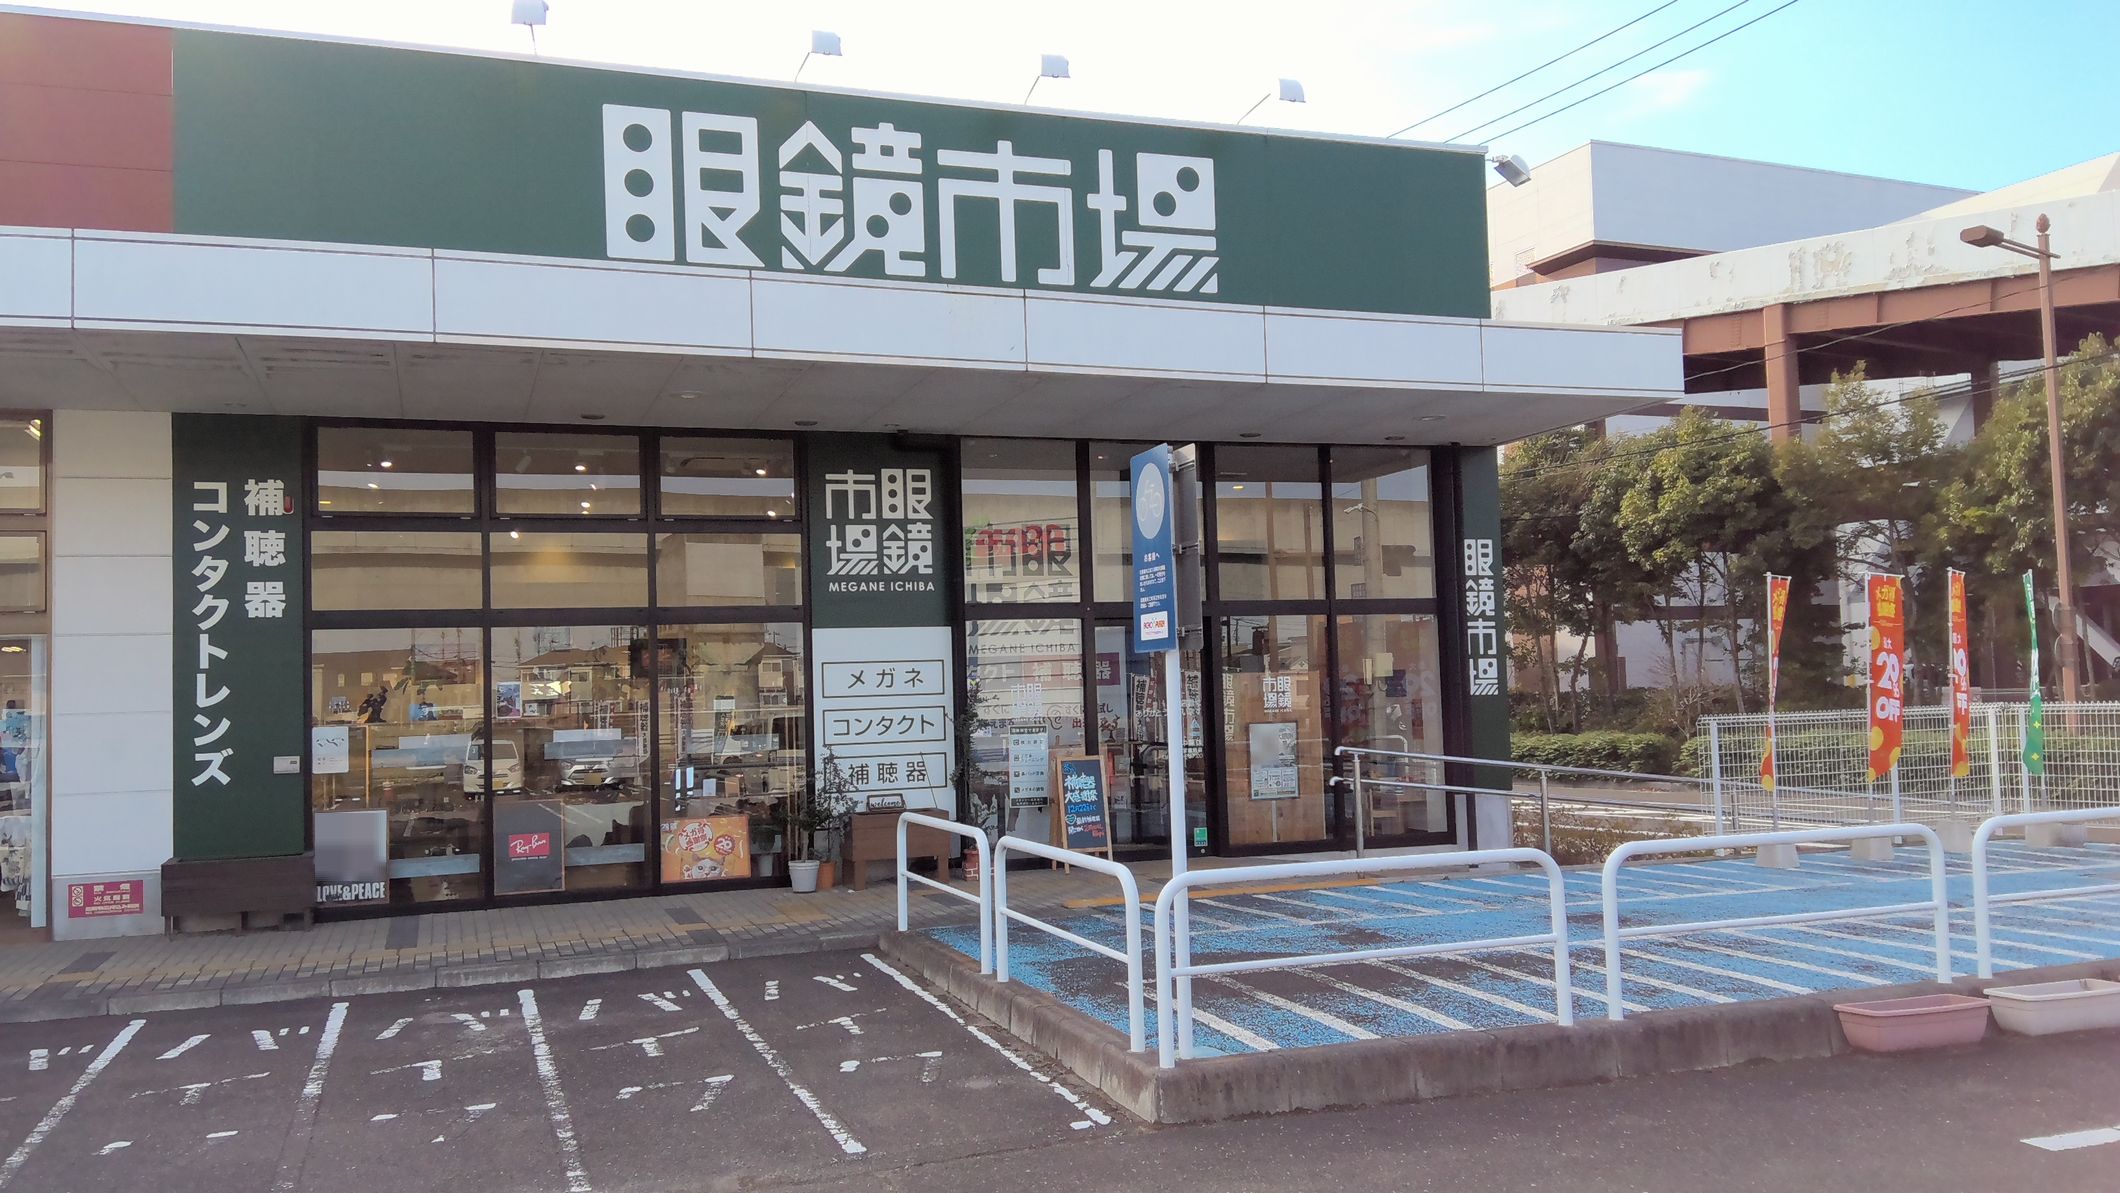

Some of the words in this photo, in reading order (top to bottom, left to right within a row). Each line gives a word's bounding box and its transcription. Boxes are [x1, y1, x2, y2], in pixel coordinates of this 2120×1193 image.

[602, 103, 1220, 295] 眼鏡市場
[244, 478, 287, 619] 補聴器
[828, 581, 885, 592] MEGANE
[890, 581, 935, 592] ICHIBA
[1464, 538, 1499, 696] 眼鏡市場
[191, 481, 234, 787] コンタクトレンズ
[848, 667, 924, 689] メガネ
[833, 713, 936, 737] コンタクト
[848, 761, 927, 785] 補聴器
[870, 797, 903, 808] welcome
[510, 835, 546, 854] Ray-Ban
[316, 881, 386, 903] LOVE&PEACE
